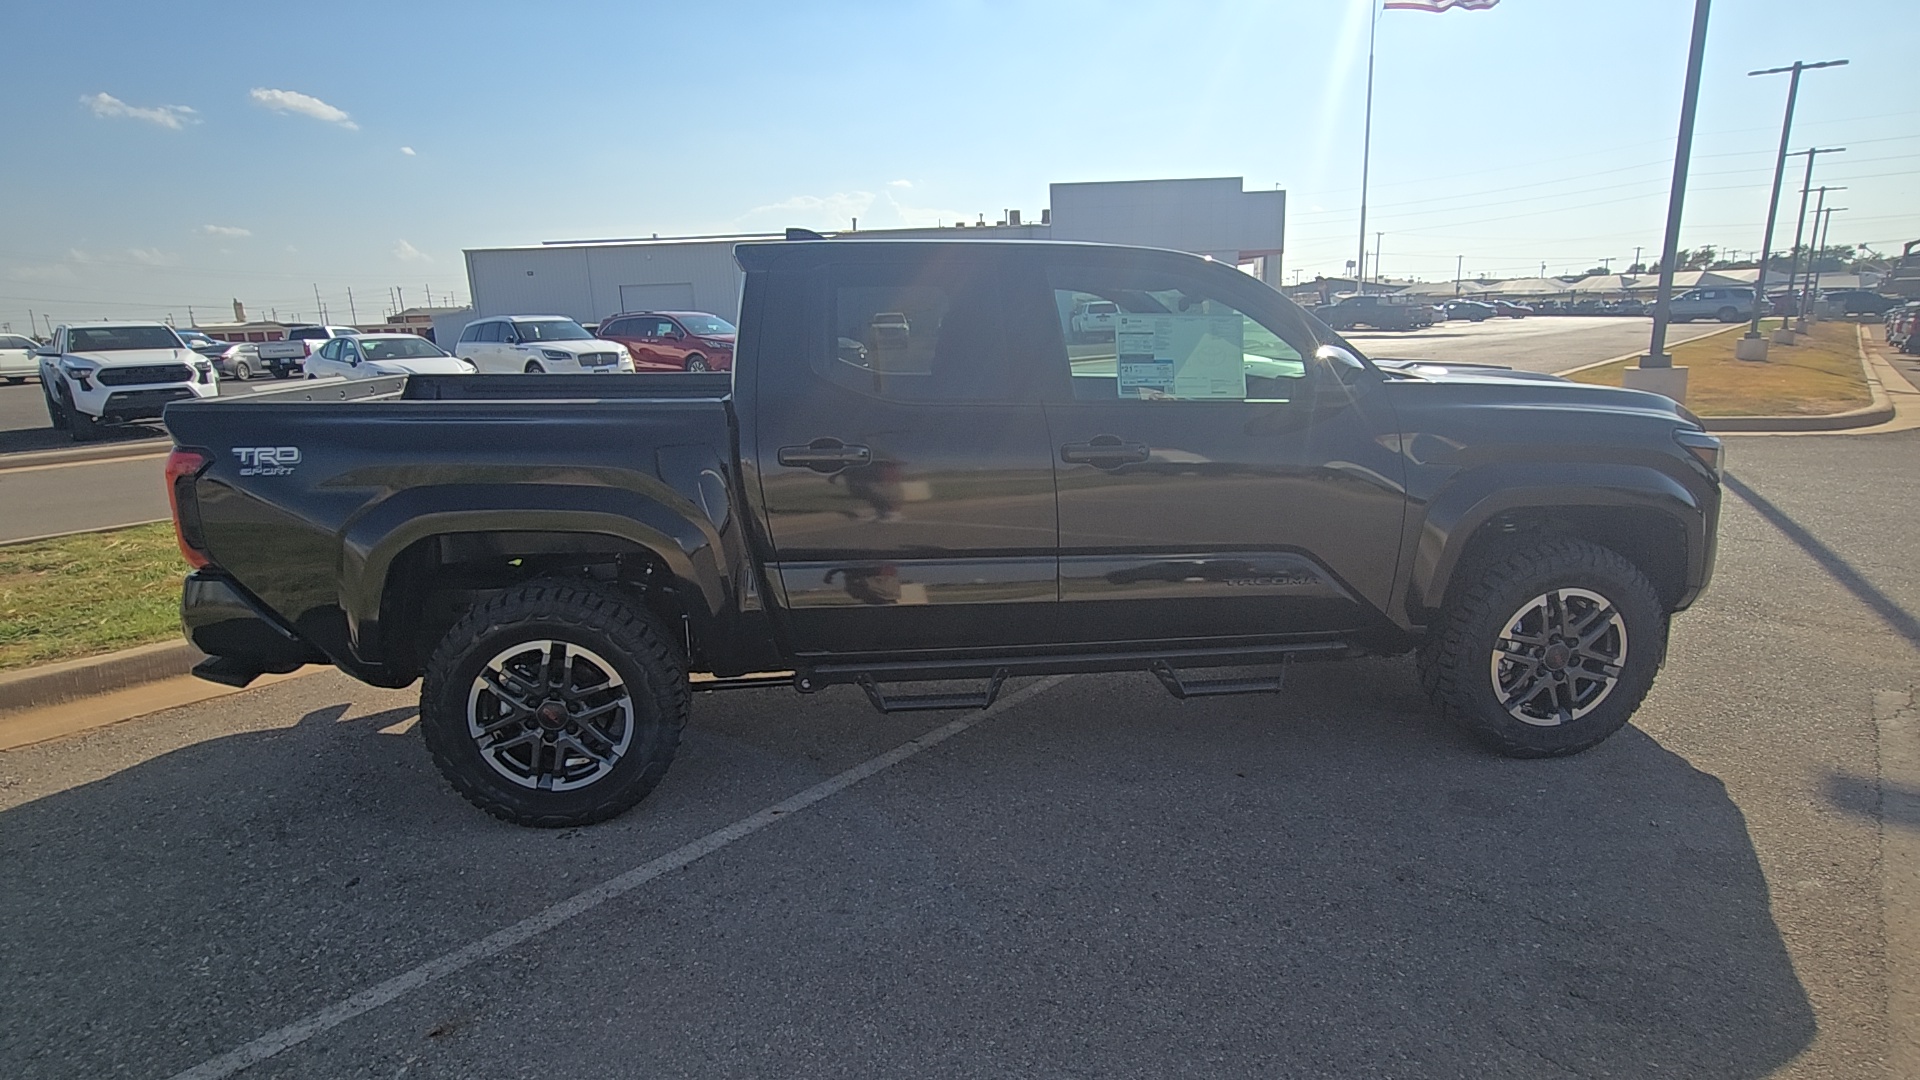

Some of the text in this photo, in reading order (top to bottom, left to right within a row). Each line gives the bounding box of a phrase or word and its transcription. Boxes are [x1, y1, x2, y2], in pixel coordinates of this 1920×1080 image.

[231, 446, 302, 465] TRD
[240, 466, 296, 476] SPORT
[1223, 577, 1320, 587] TACOMA
